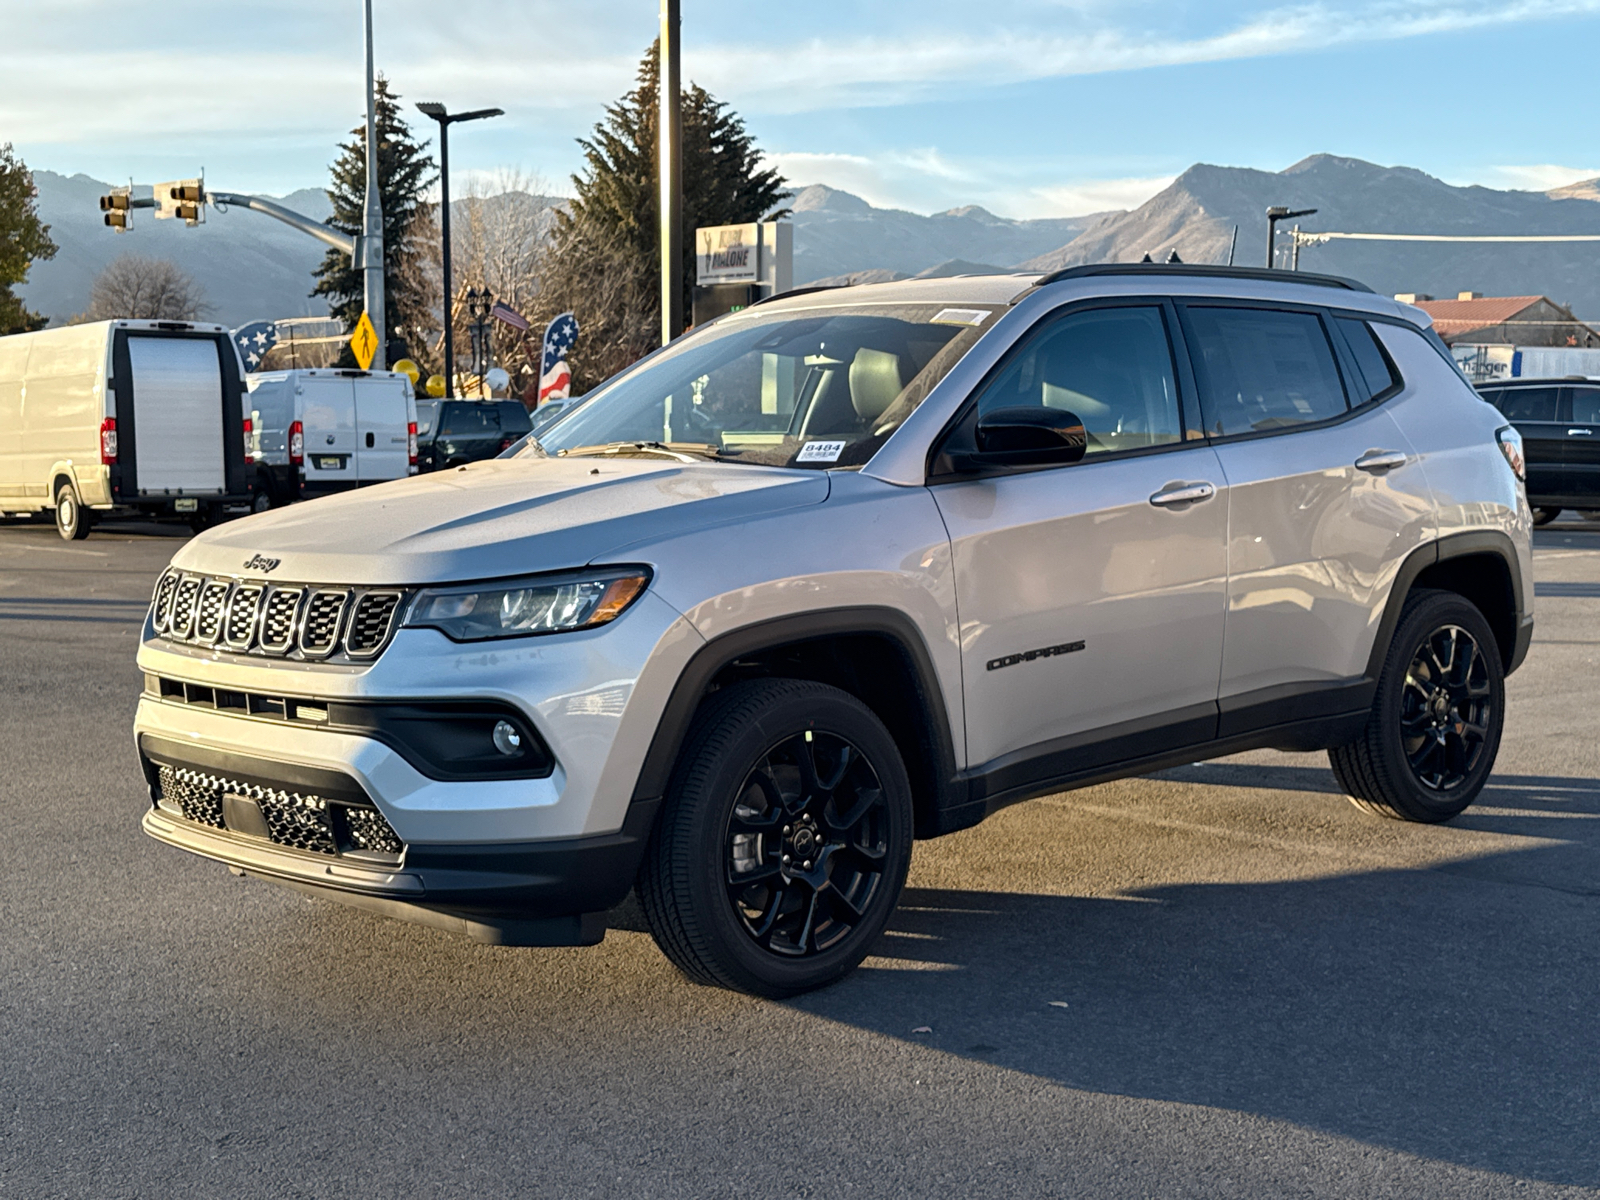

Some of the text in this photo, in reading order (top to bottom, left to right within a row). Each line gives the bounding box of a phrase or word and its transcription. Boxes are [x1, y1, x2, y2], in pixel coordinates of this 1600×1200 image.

[712, 249, 749, 270] MALONE
[805, 444, 841, 452] 8484
[243, 554, 281, 573] Jeep
[986, 640, 1086, 671] COMPASS
